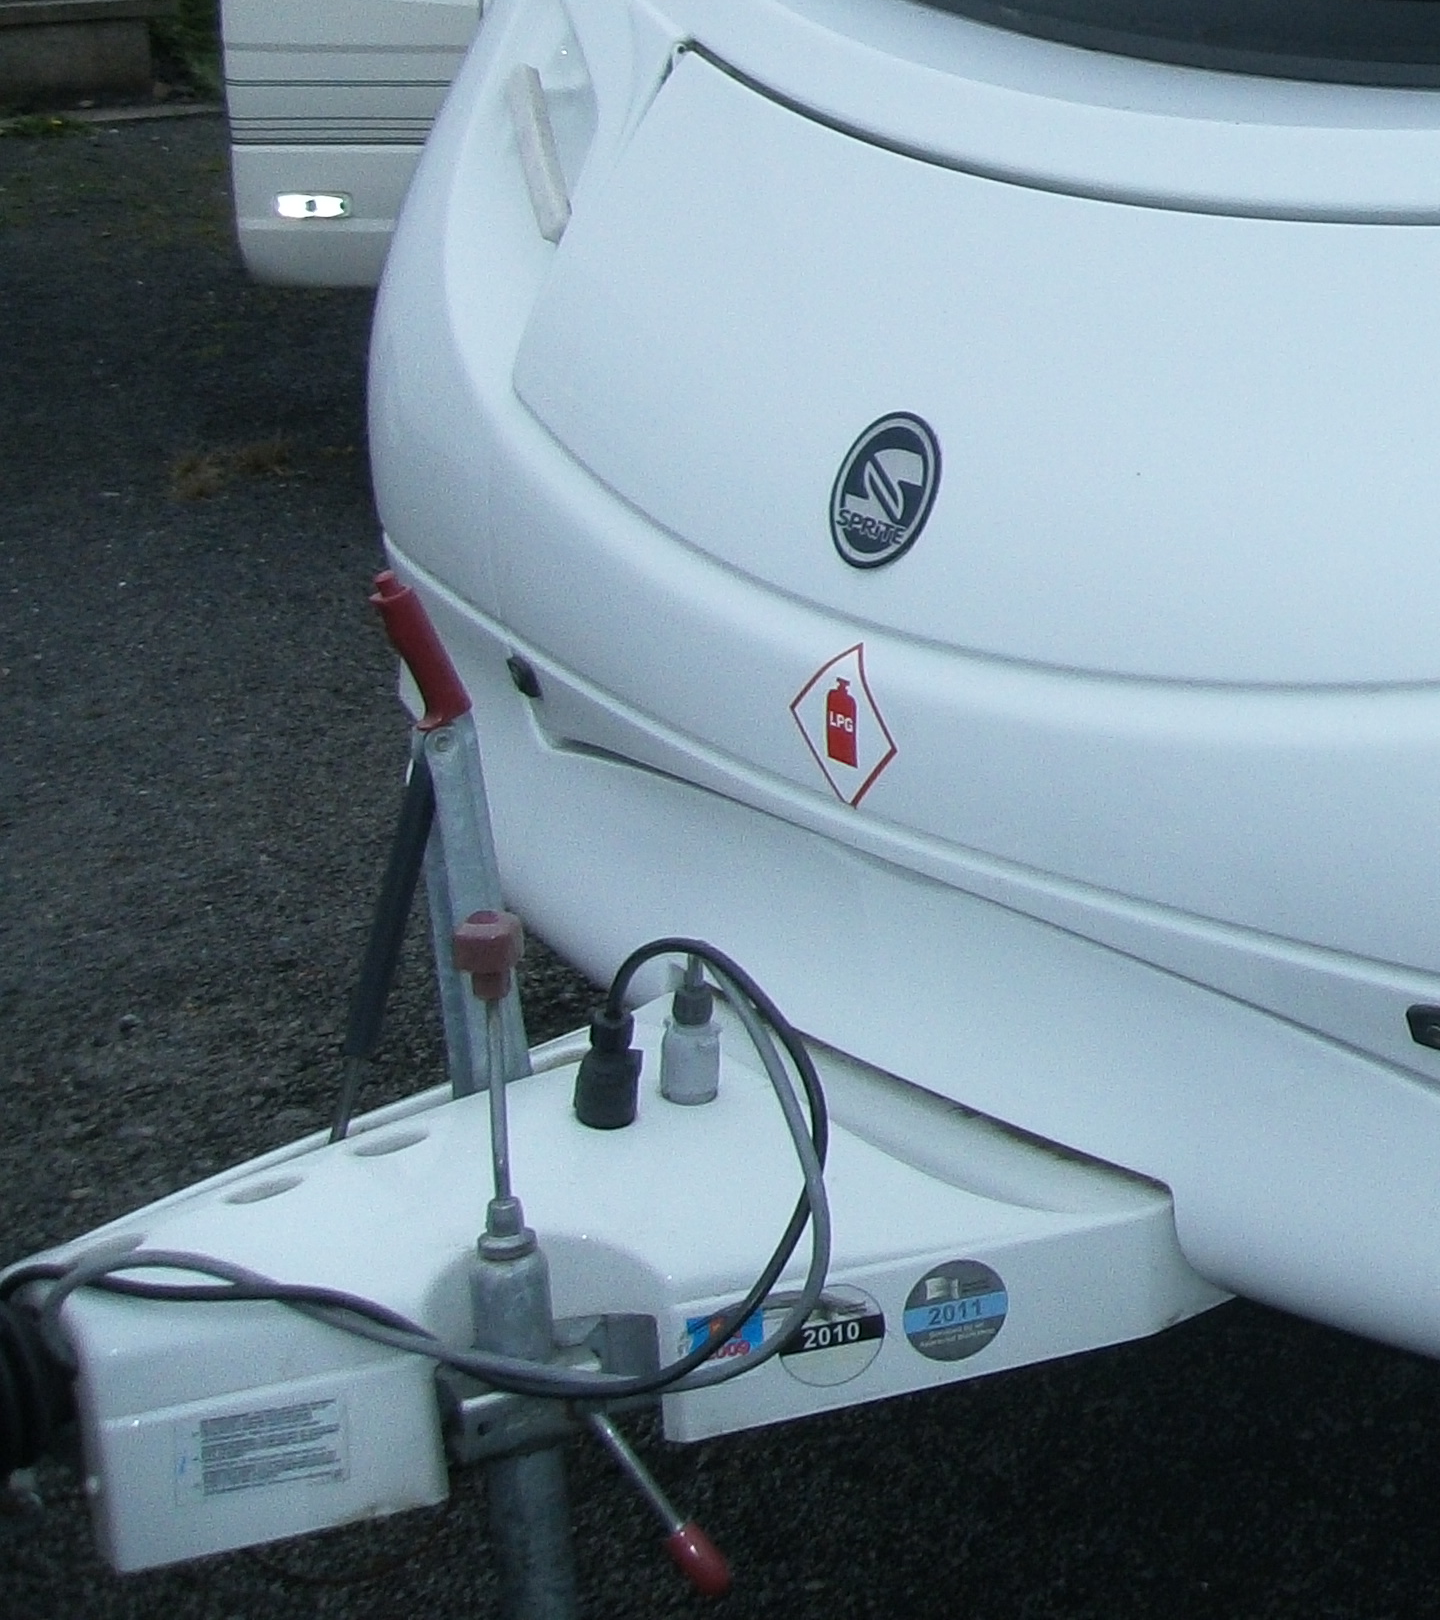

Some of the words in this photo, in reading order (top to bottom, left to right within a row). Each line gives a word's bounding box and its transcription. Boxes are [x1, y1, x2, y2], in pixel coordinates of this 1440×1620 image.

[829, 710, 854, 733] LPG
[928, 1298, 981, 1326] 2011
[803, 1321, 861, 1350] 2010
